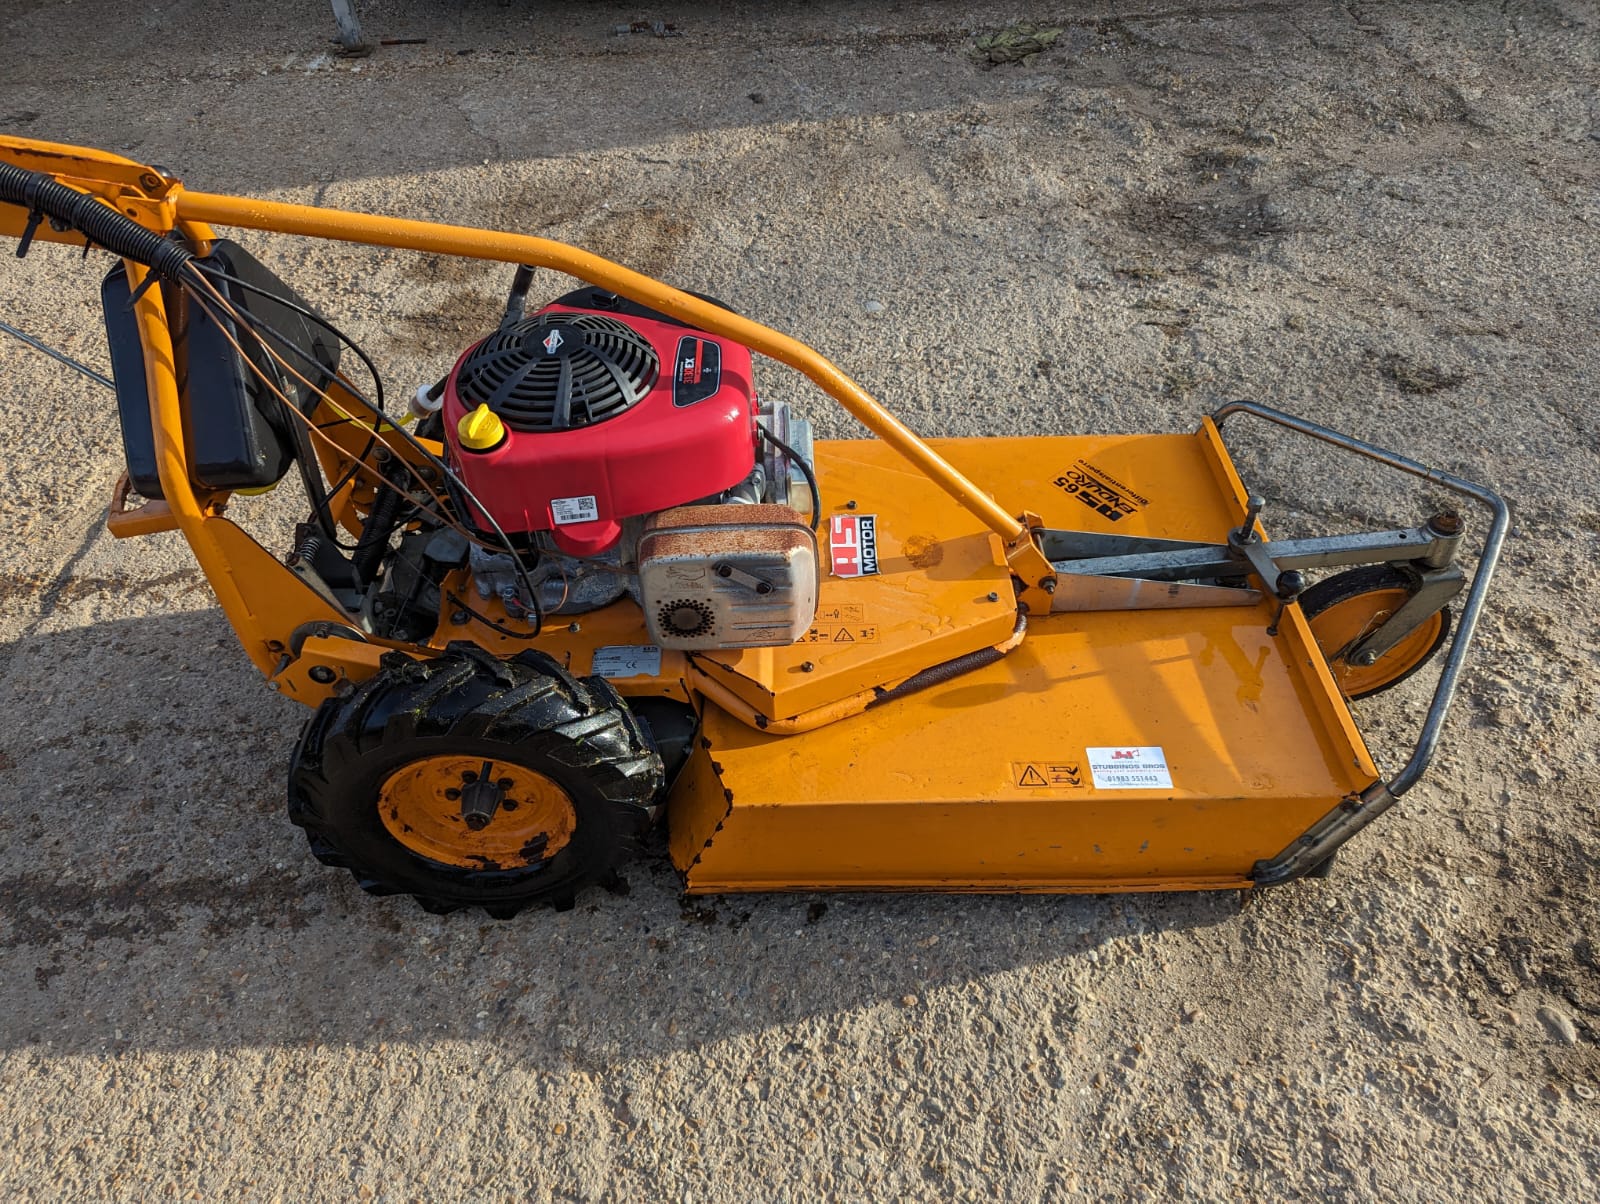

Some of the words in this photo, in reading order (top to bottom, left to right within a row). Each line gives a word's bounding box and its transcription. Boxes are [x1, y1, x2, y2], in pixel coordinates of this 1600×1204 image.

[1053, 477, 1079, 493] 65
[1066, 471, 1138, 514] ENDURO
[1075, 491, 1123, 521] AS
[832, 516, 858, 574] AS
[861, 520, 876, 572] MOTOR
